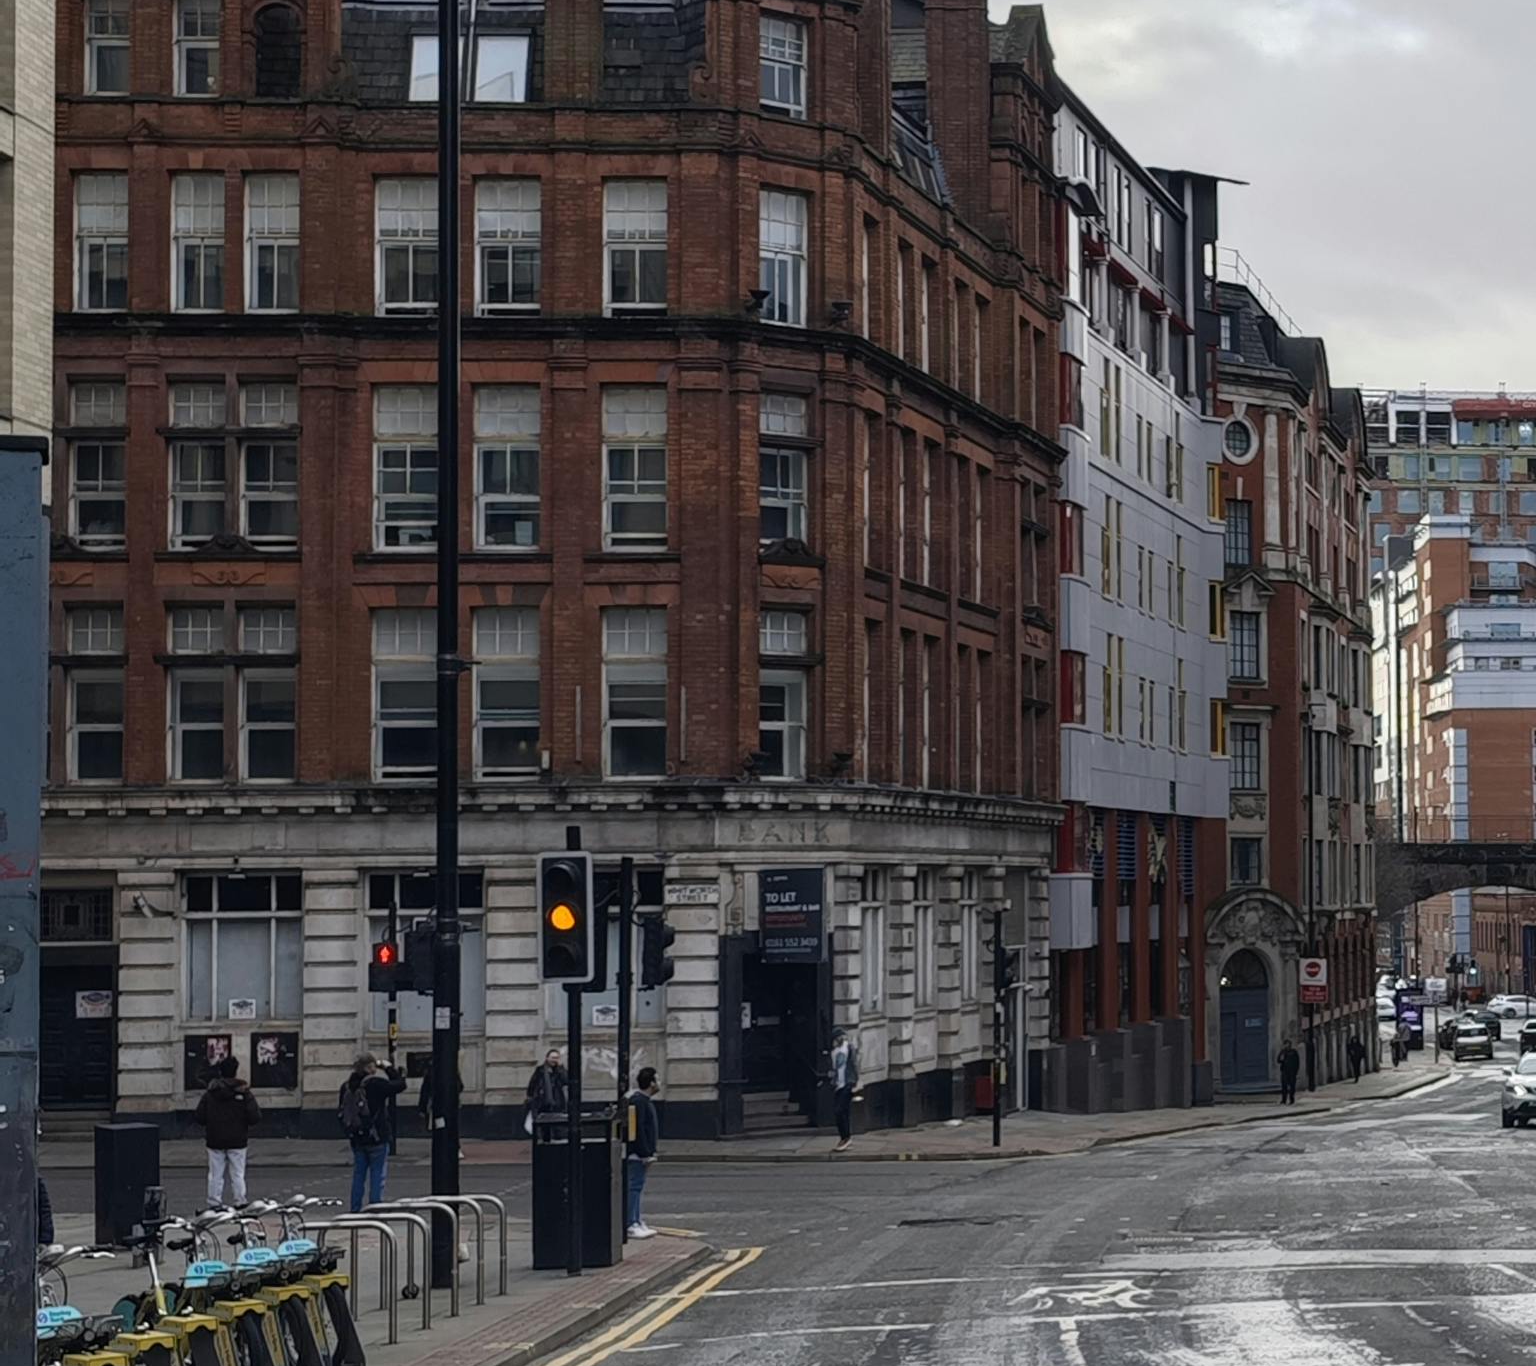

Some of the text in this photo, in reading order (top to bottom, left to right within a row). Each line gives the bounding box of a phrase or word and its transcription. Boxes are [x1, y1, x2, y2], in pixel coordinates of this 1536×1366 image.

[738, 821, 830, 843] BANK
[765, 892, 796, 903] TO LET
